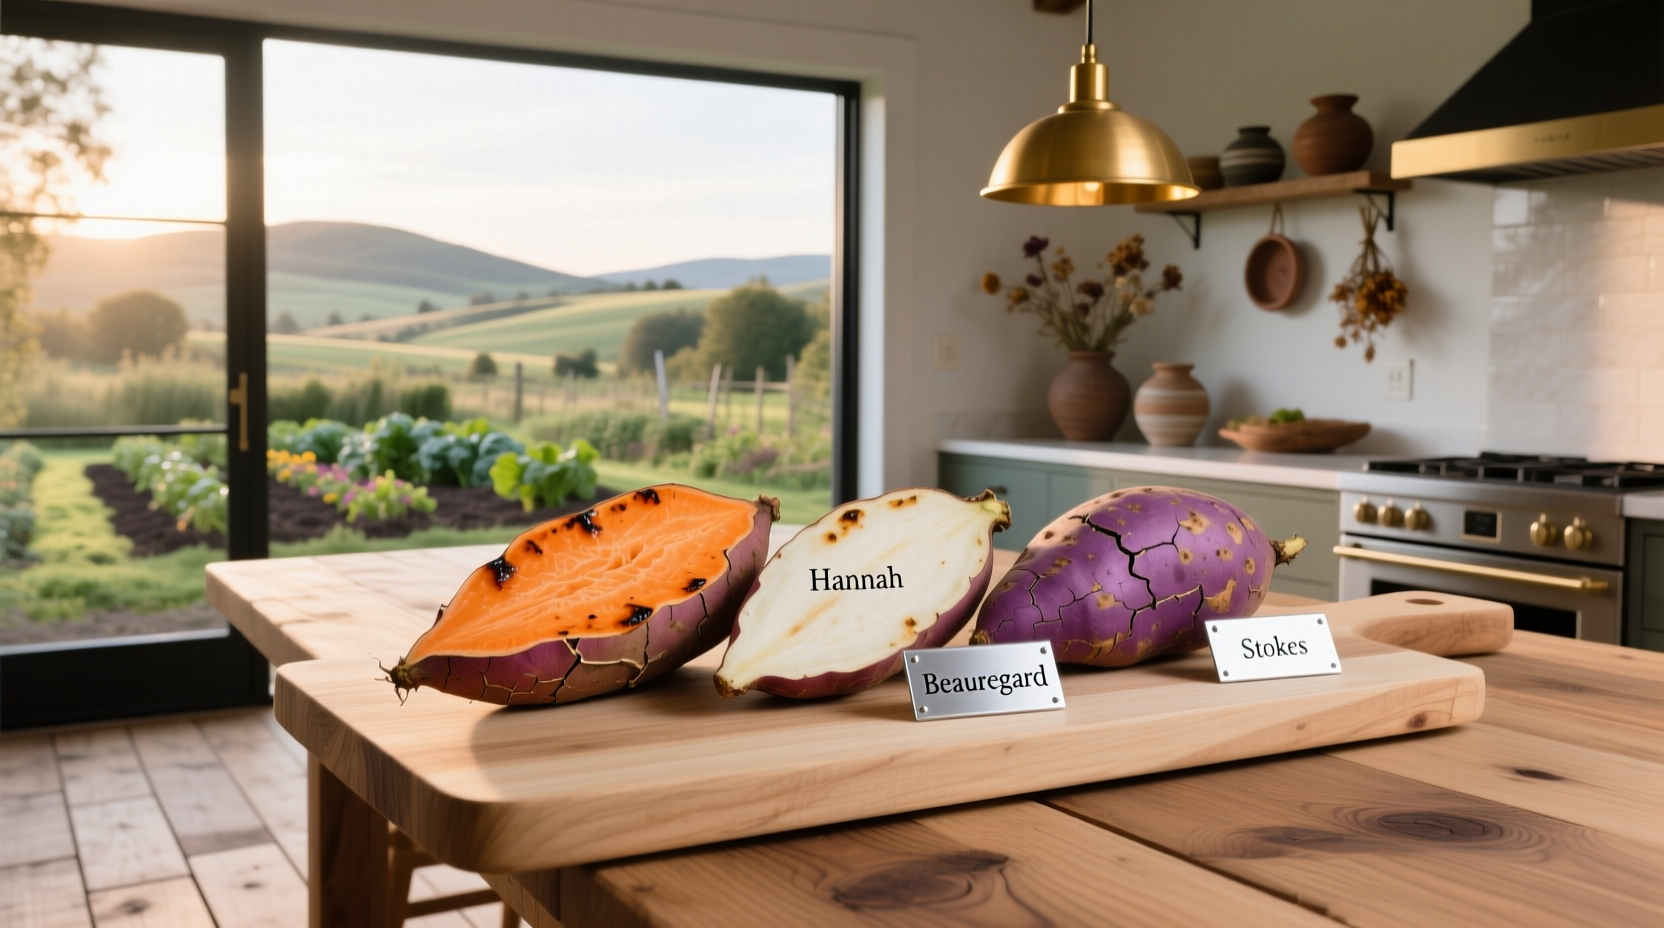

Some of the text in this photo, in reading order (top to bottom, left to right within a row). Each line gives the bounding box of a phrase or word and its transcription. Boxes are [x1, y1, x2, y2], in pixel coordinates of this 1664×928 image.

[809, 565, 904, 591] Hannah
[1241, 635, 1308, 660] Stokes
[922, 664, 1049, 696] Beauregard
